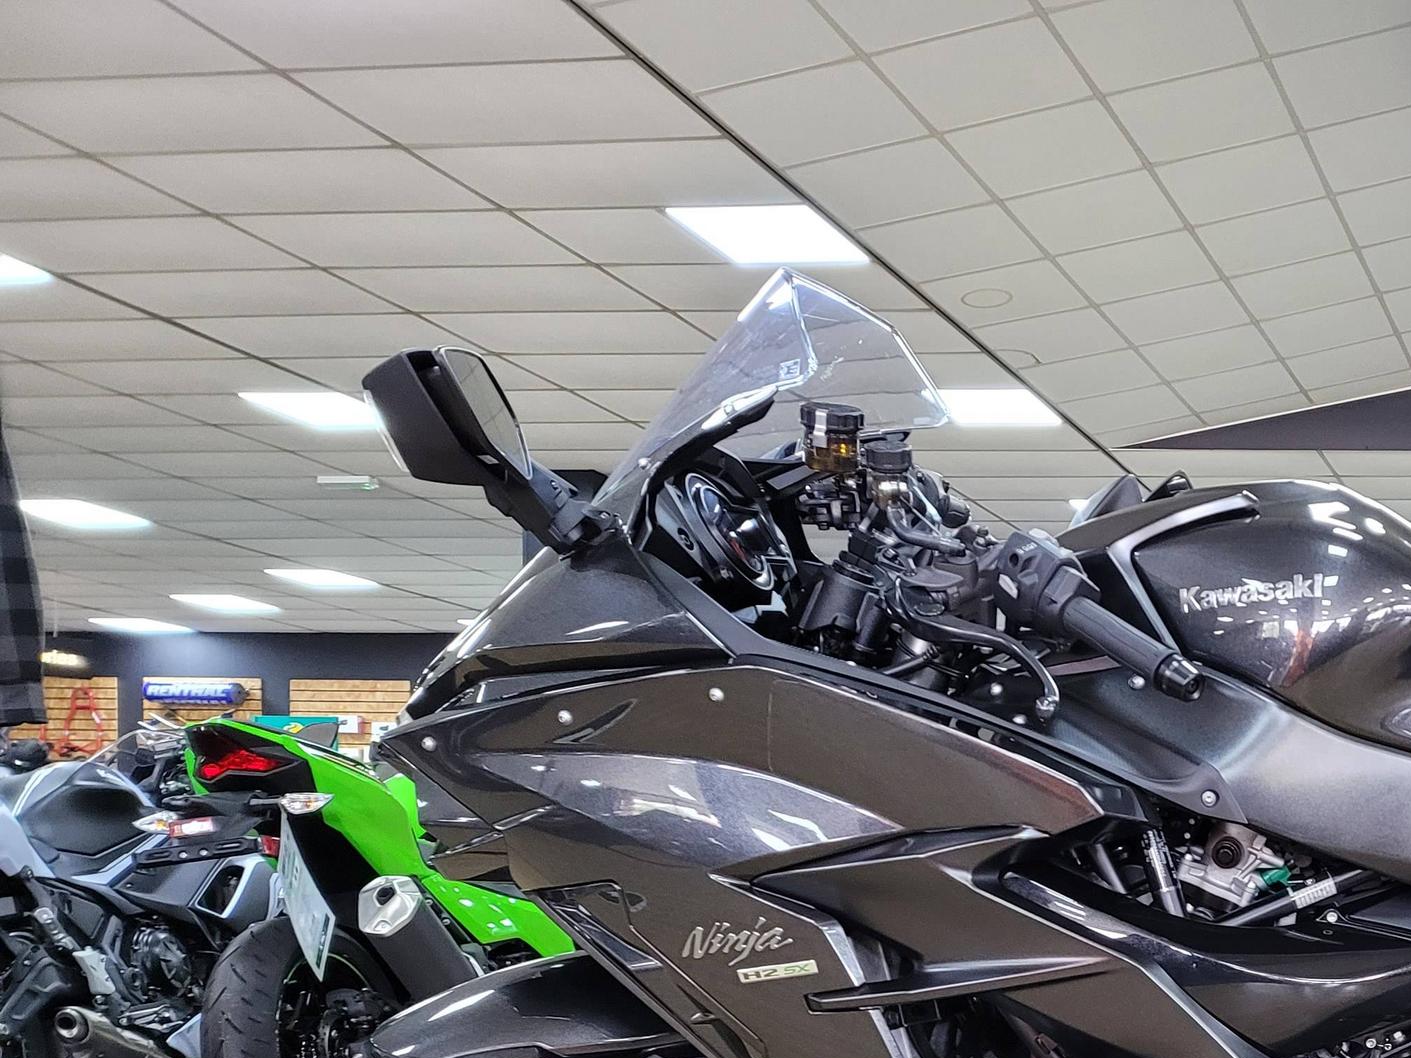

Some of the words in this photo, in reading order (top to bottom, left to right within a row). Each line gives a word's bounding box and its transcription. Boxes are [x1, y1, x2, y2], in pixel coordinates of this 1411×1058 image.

[1179, 572, 1324, 614] Kawasaki
[681, 916, 794, 967] Ninja
[743, 968, 778, 981] H2
[783, 962, 811, 976] SX
